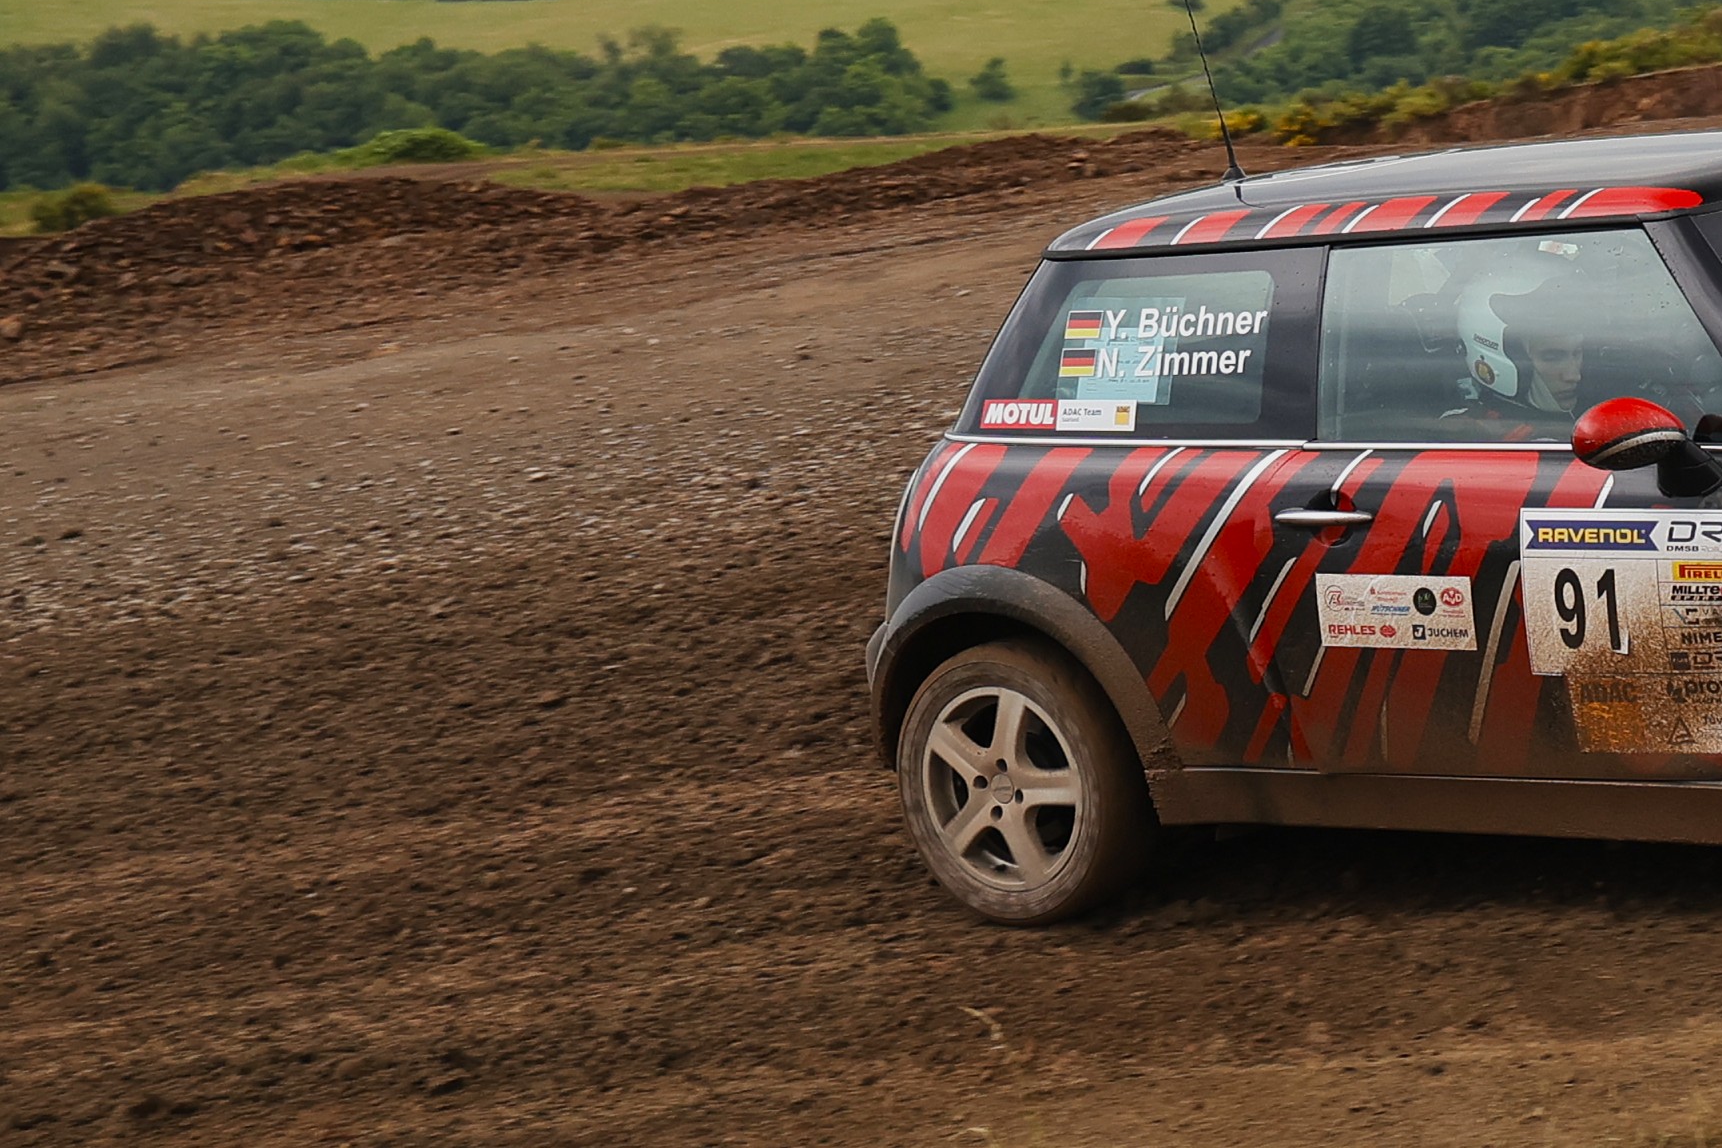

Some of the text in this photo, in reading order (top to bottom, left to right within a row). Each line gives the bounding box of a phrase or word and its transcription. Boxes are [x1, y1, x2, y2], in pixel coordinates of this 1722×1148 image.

[1105, 305, 1267, 340] Y. Büchner
[1096, 345, 1251, 378] N. Zimmer
[983, 403, 1055, 425] MOTUL
[1062, 408, 1102, 416] ADAC Team
[1538, 527, 1646, 543] RAVENOL
[1554, 567, 1621, 651] 91
[1328, 624, 1376, 636] REHLES
[1427, 628, 1469, 638] JUCHEM
